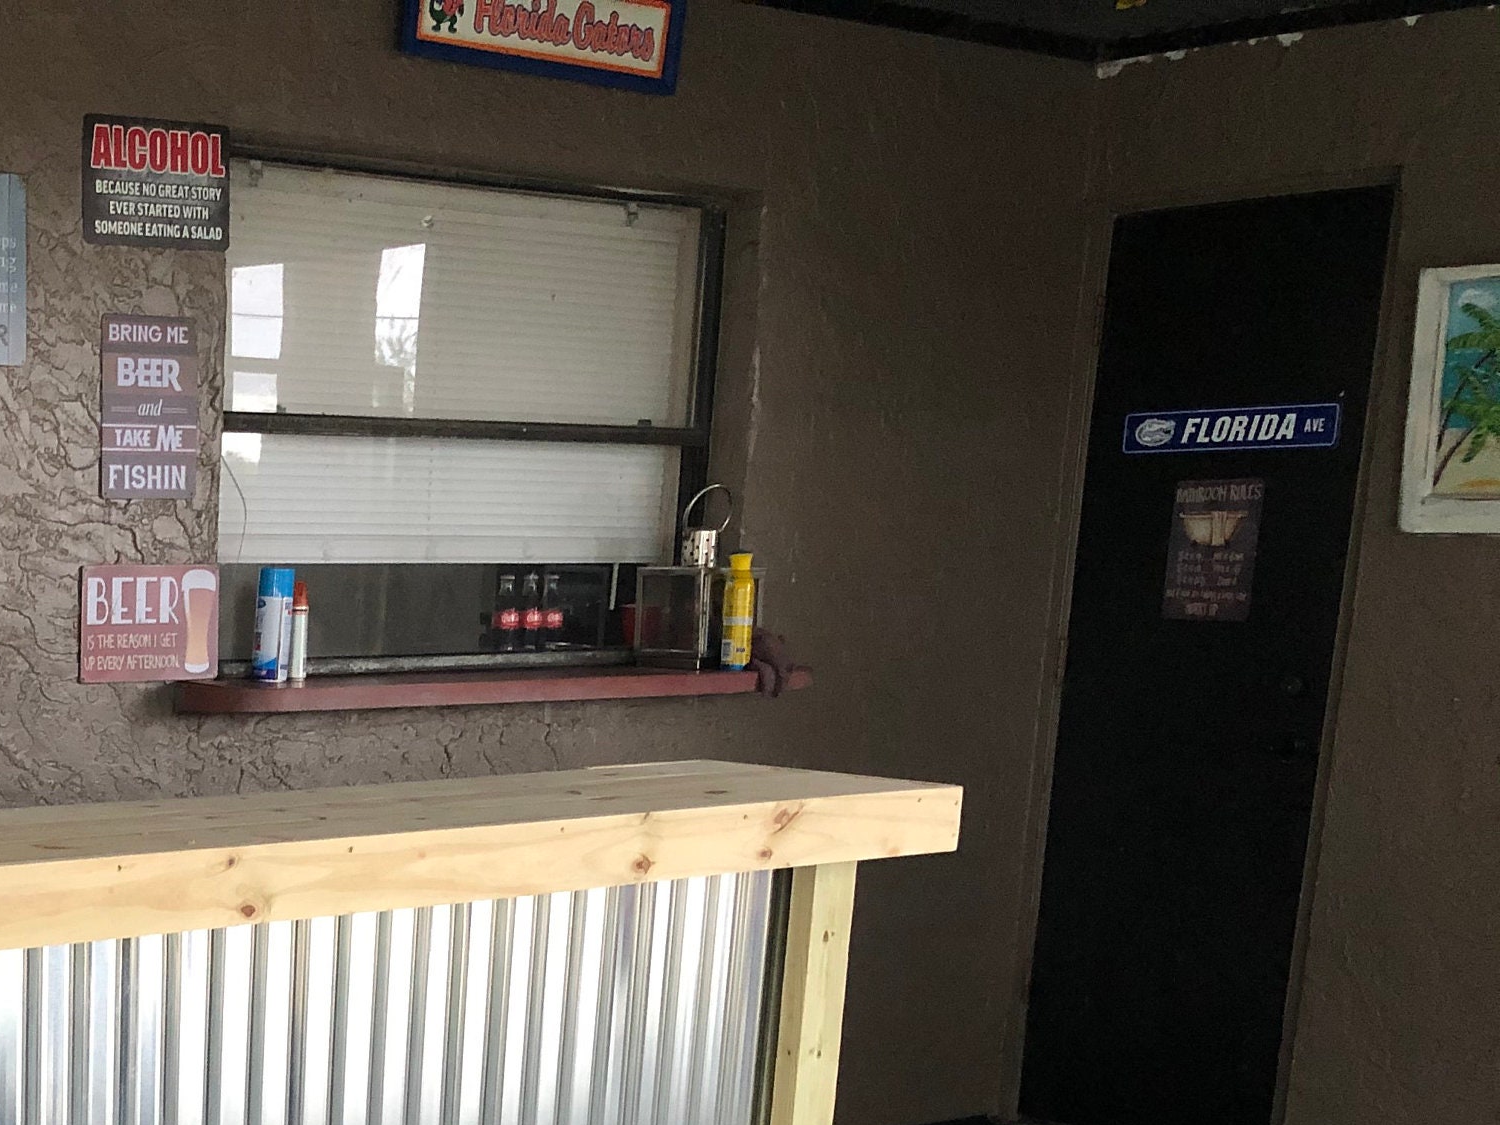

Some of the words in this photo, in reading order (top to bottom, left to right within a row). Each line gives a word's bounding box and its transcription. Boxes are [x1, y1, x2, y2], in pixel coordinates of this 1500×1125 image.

[473, 0, 572, 47] Florida
[572, 2, 655, 61] Gators
[91, 123, 225, 178] ALCOHOL
[95, 179, 140, 196] BECAUSE
[142, 183, 156, 197] NO
[158, 184, 189, 199] GREAT
[191, 187, 222, 201] STORY
[109, 201, 136, 215] EVER
[137, 203, 181, 218] STARTED
[182, 205, 209, 220] WITH
[95, 220, 143, 236] SOMEONE
[145, 223, 180, 238] EATING
[182, 225, 190, 238] A
[191, 225, 222, 241] SALAD
[108, 323, 162, 343] BRING
[166, 326, 189, 345] ME
[117, 357, 182, 392] BEER
[138, 399, 163, 417] and
[115, 429, 151, 448] TAKE
[1180, 413, 1298, 444] FLORIDA
[1303, 417, 1326, 433] AVE
[108, 464, 187, 491] FISHIN
[86, 576, 180, 626] BEER
[87, 634, 95, 651] IS
[97, 633, 115, 649] THE
[116, 632, 152, 649] REASON
[153, 633, 157, 648] I
[160, 632, 178, 648] GET
[84, 656, 96, 671] UP
[97, 655, 125, 671] EVERY
